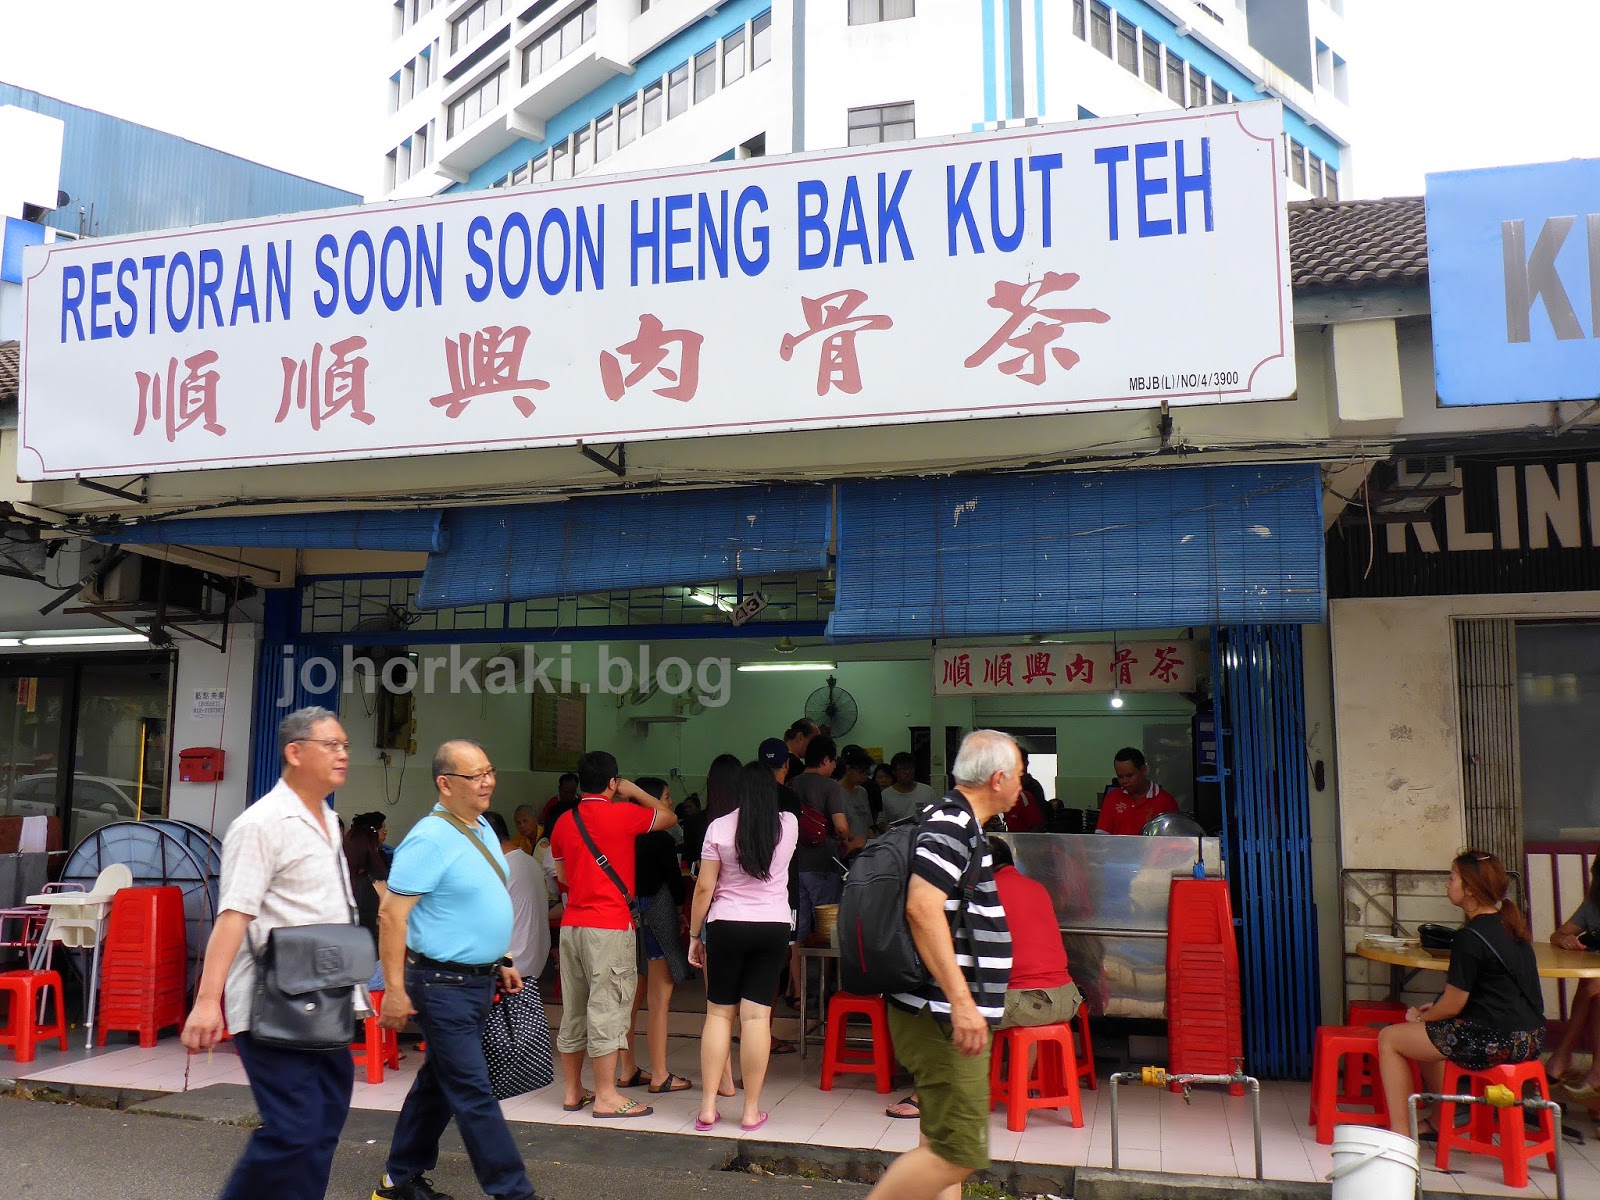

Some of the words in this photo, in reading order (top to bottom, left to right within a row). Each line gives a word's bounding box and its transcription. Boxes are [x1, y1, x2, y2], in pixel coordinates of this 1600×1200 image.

[61, 239, 292, 342] RESTORAN
[313, 222, 443, 319] SOON
[465, 203, 605, 303] SOON
[630, 185, 770, 287] HENG
[797, 169, 915, 271] BAK
[946, 152, 1063, 257] KUT
[1094, 137, 1215, 241] TEH
[133, 271, 1111, 442] 順順興肉骨茶
[1129, 371, 1239, 391] MBJB(L)/NO/4/3900
[942, 647, 1185, 687] 順順興肉骨茶
